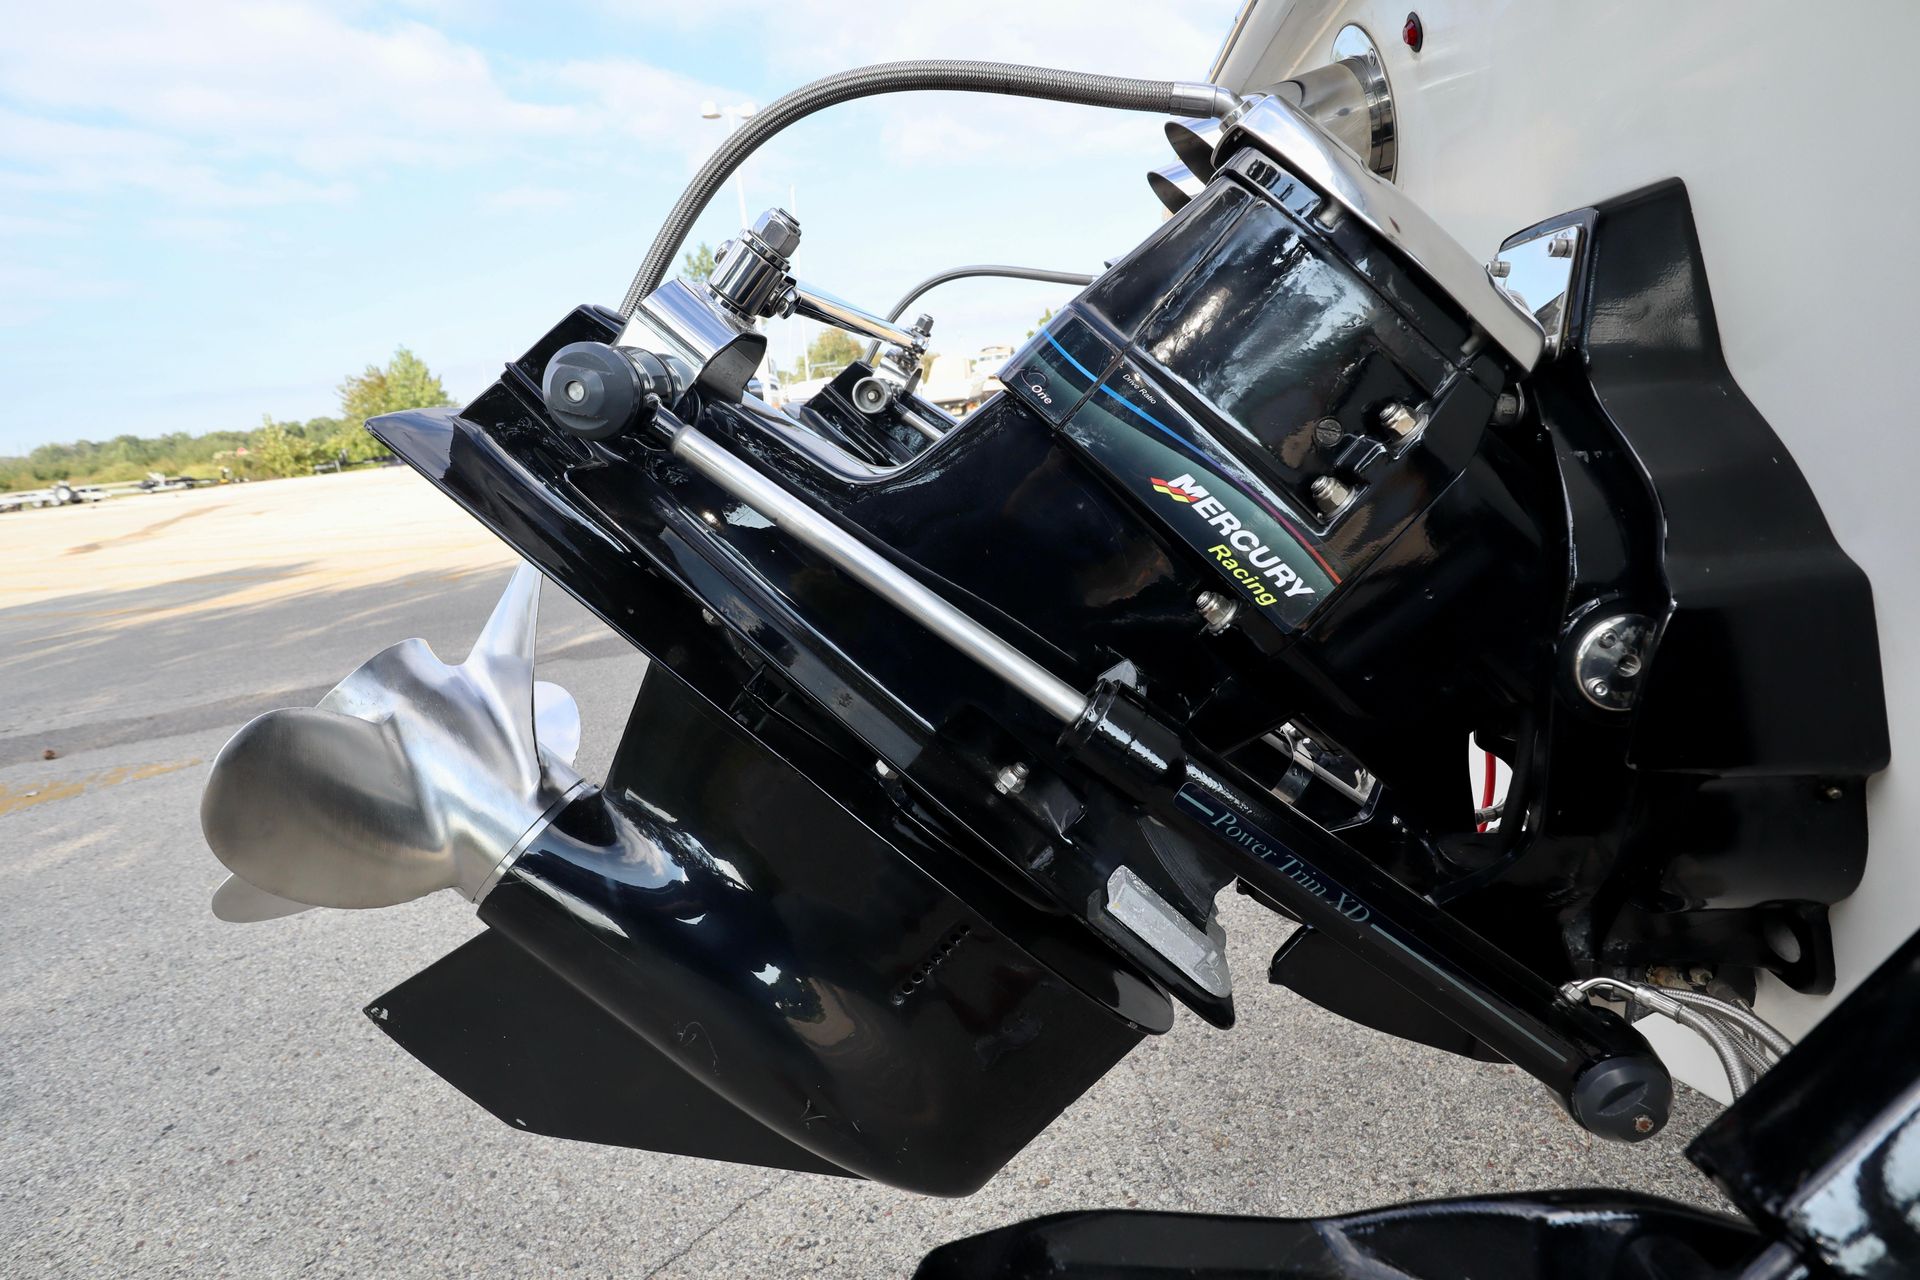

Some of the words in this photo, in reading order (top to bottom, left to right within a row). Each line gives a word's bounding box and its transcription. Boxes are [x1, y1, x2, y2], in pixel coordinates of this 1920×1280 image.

[1031, 384, 1052, 405] One
[1122, 373, 1140, 390] Drive
[1167, 473, 1315, 599] MERCURY
[1207, 544, 1278, 607] Racing
[1211, 811, 1278, 860] Power
[1277, 853, 1327, 897] Trim
[1332, 892, 1371, 923] XD
